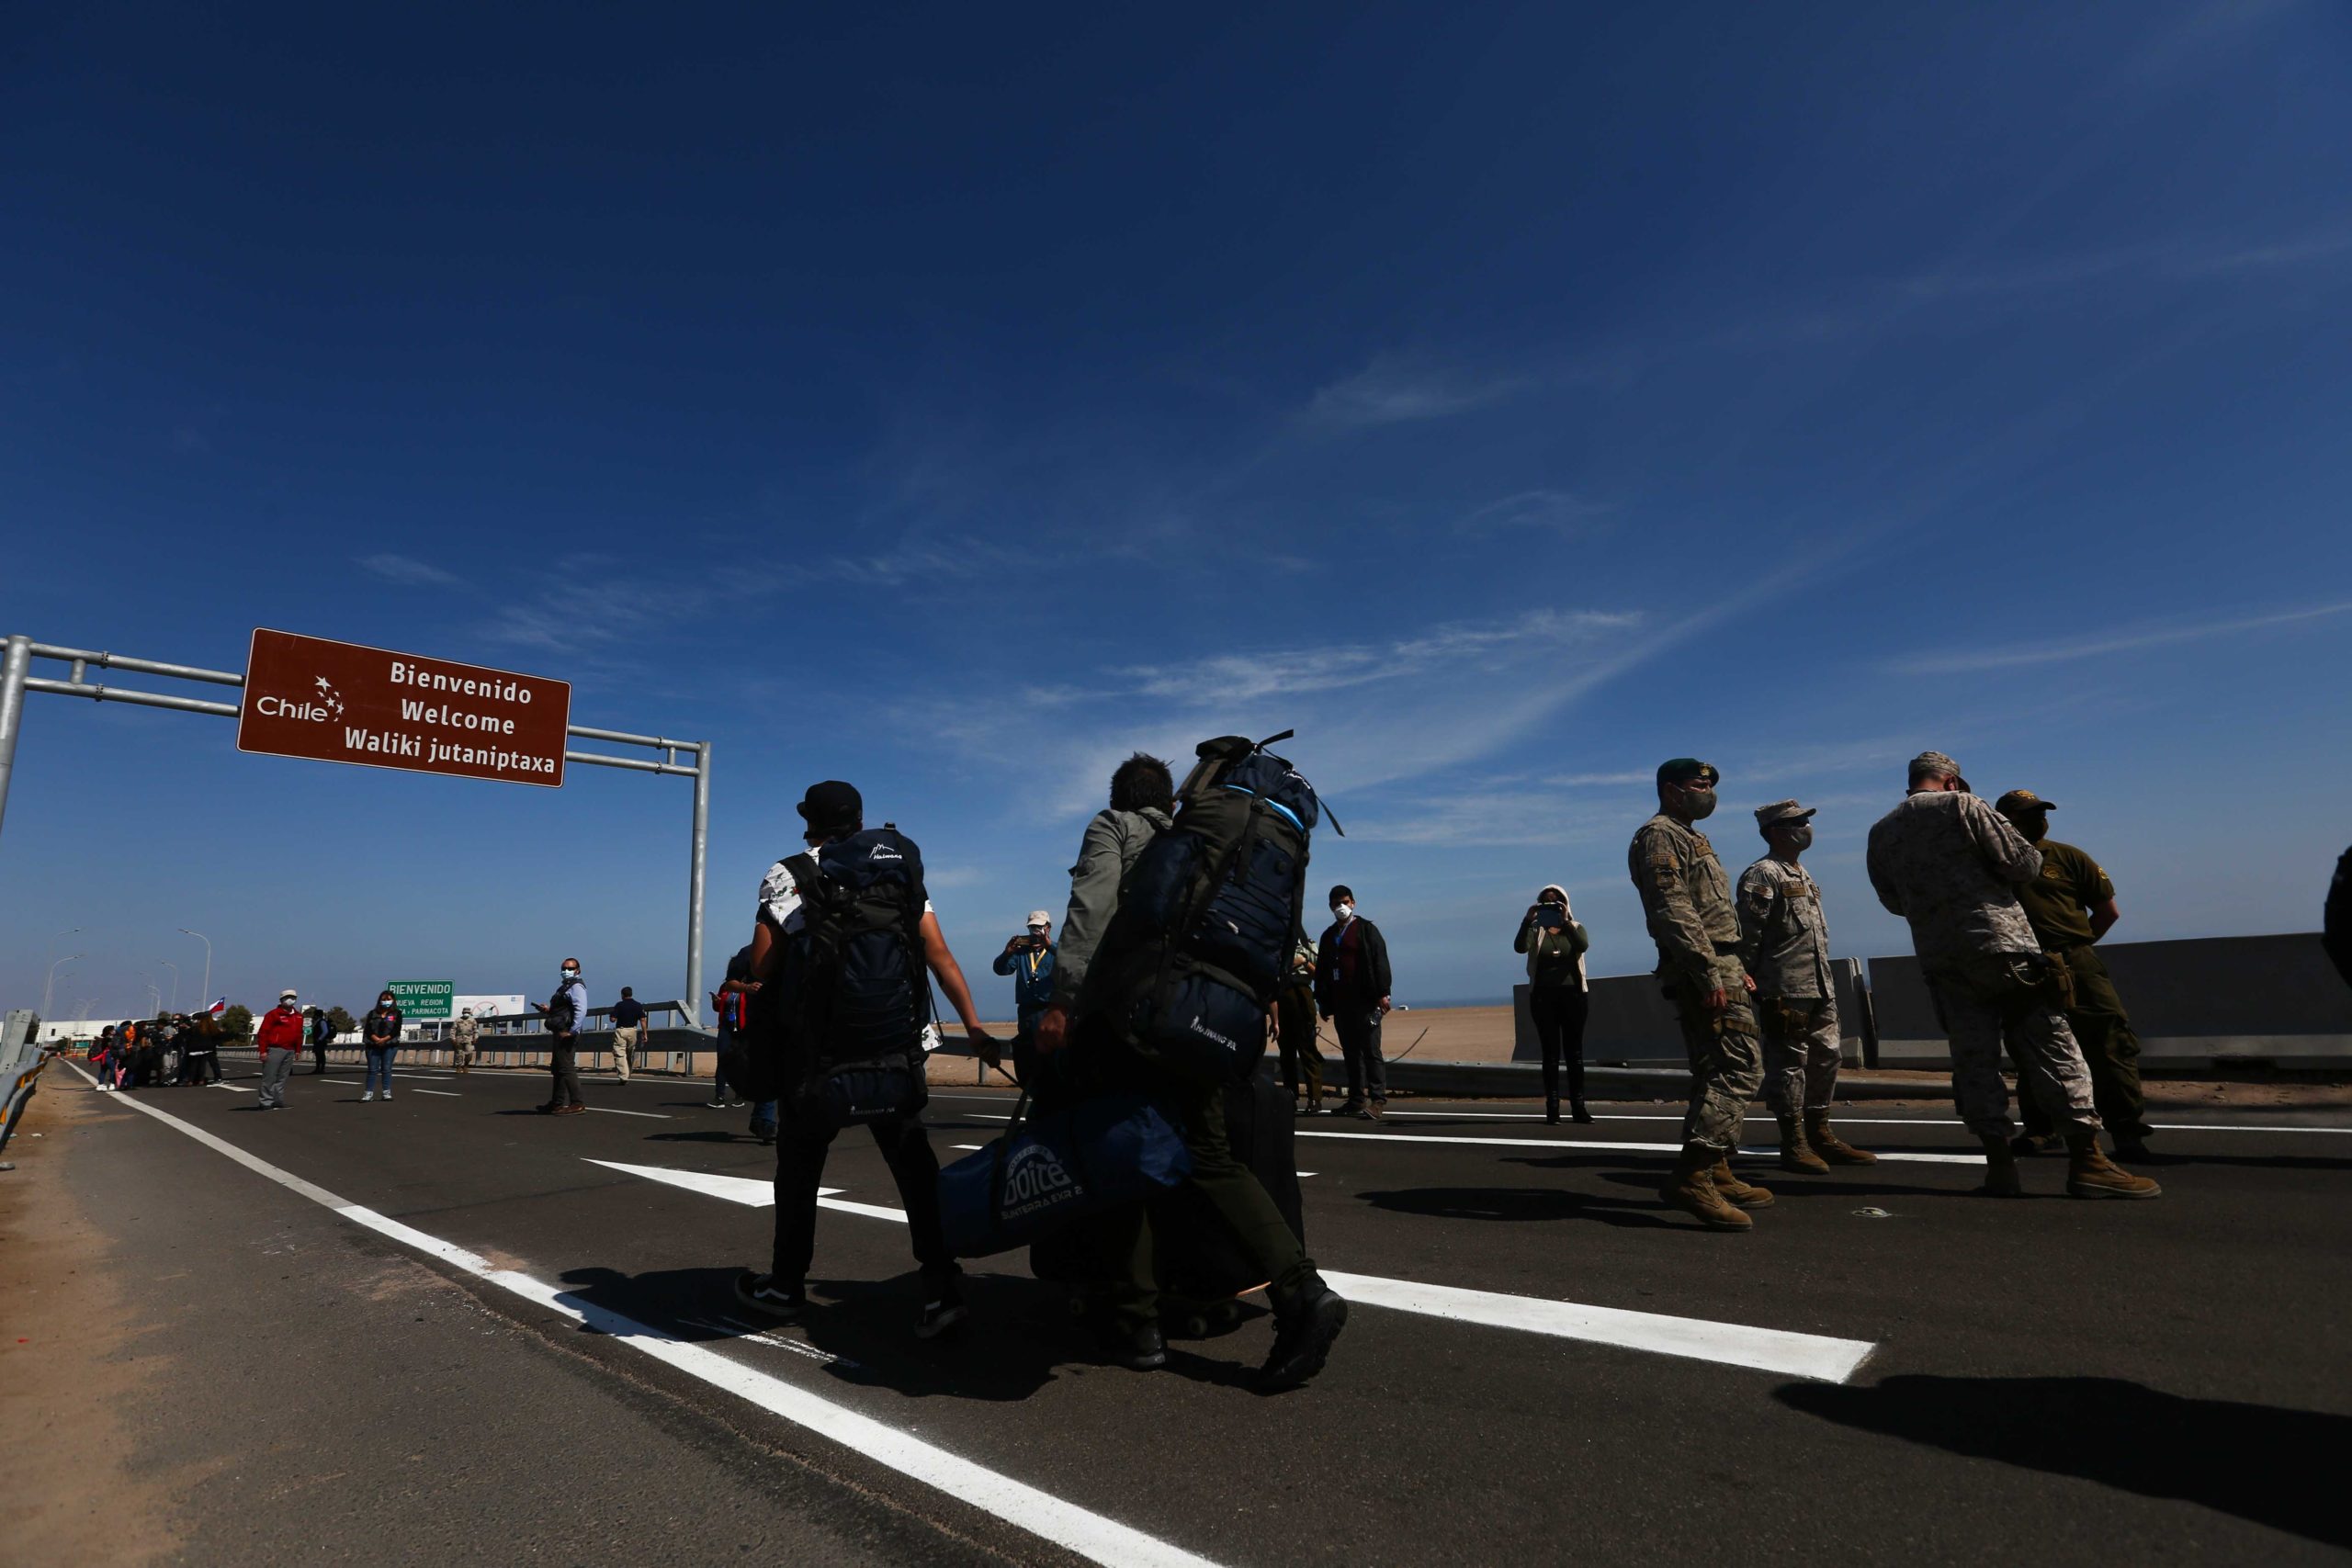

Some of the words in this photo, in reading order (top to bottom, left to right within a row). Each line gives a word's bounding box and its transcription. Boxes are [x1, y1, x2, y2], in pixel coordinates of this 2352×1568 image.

[390, 661, 532, 705] Bienvenido
[256, 695, 328, 723] Chile
[401, 698, 515, 735] Welcome
[345, 727, 422, 757] Waliki
[426, 738, 556, 773] jutaniptaxa
[389, 984, 451, 995] BIENVENIDO
